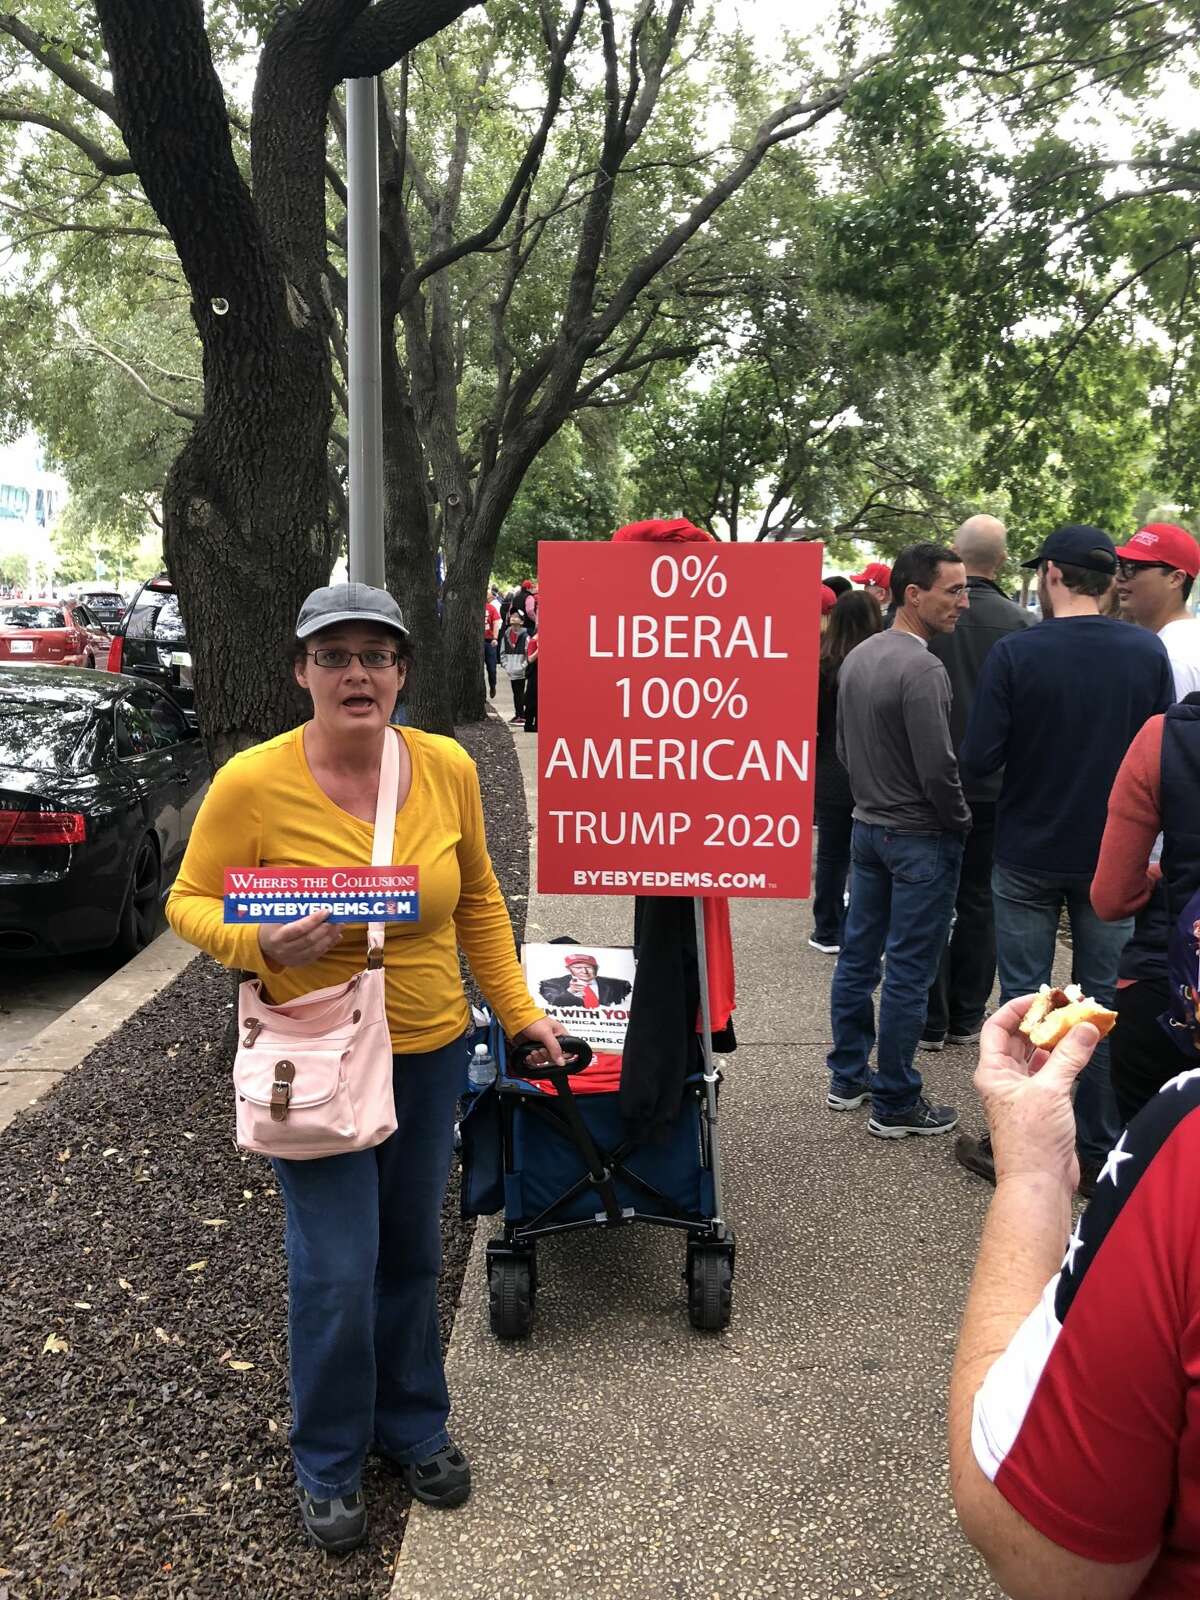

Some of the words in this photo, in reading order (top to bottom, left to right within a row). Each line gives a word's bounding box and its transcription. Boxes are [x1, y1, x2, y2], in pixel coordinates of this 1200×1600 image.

[650, 554, 728, 598] 0%
[589, 615, 789, 659] LIBERAL
[615, 677, 748, 720] 100%
[544, 737, 809, 782] AMERICAN
[549, 810, 692, 846] TRUMP
[703, 813, 801, 848] 2020
[301, 877, 328, 888] THE
[573, 870, 766, 889] BYEBYEDEMS.COM
[560, 1009, 600, 1019] WITH
